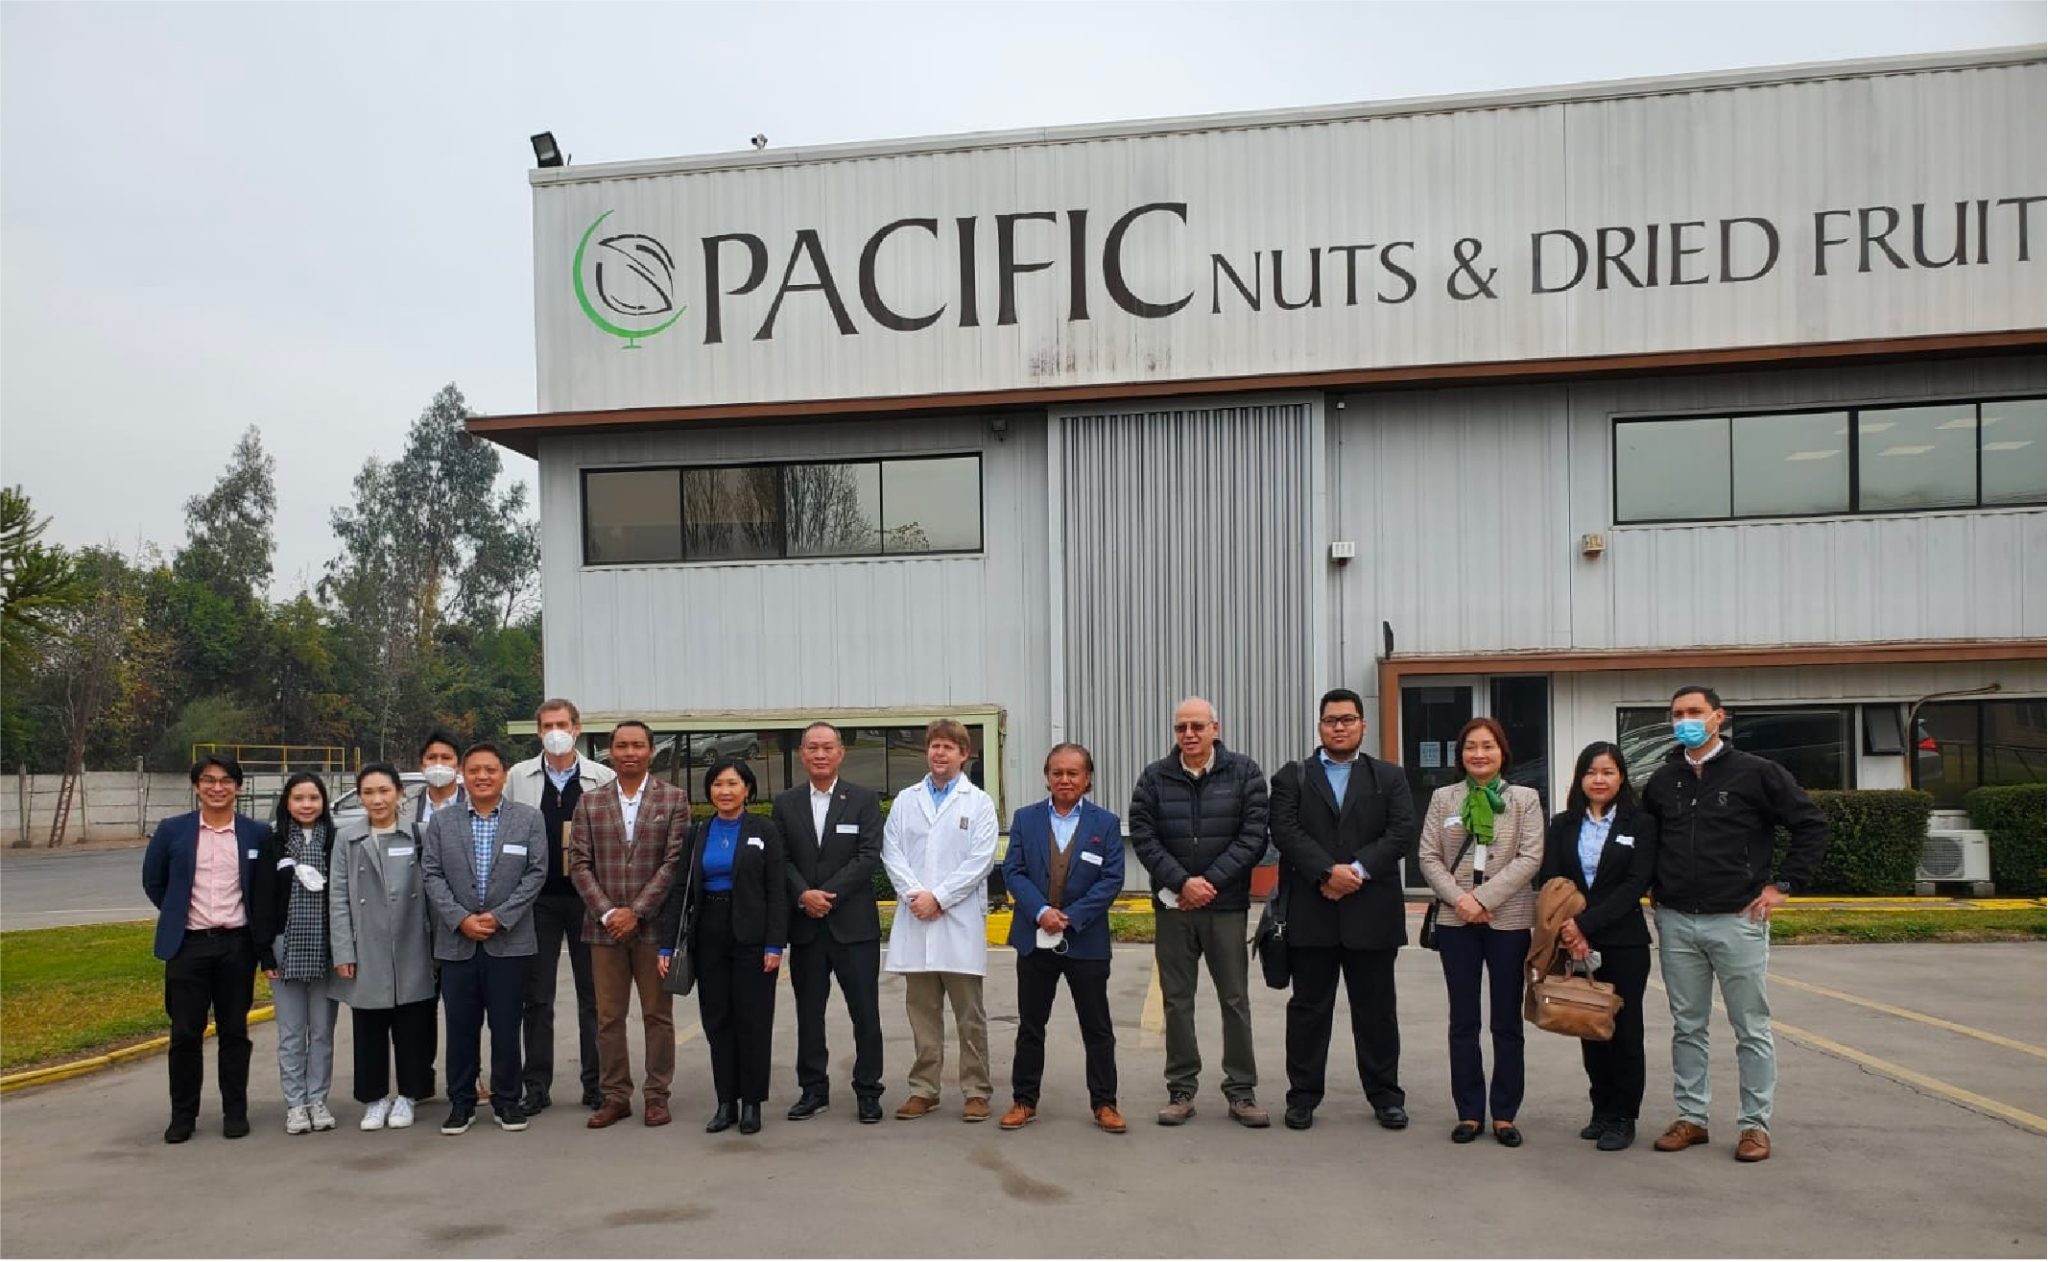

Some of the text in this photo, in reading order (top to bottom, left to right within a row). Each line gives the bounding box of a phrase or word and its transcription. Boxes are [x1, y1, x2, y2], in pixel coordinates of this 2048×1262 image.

[700, 195, 2047, 344] PACIFIC NUTS & DRIED FRUIT
